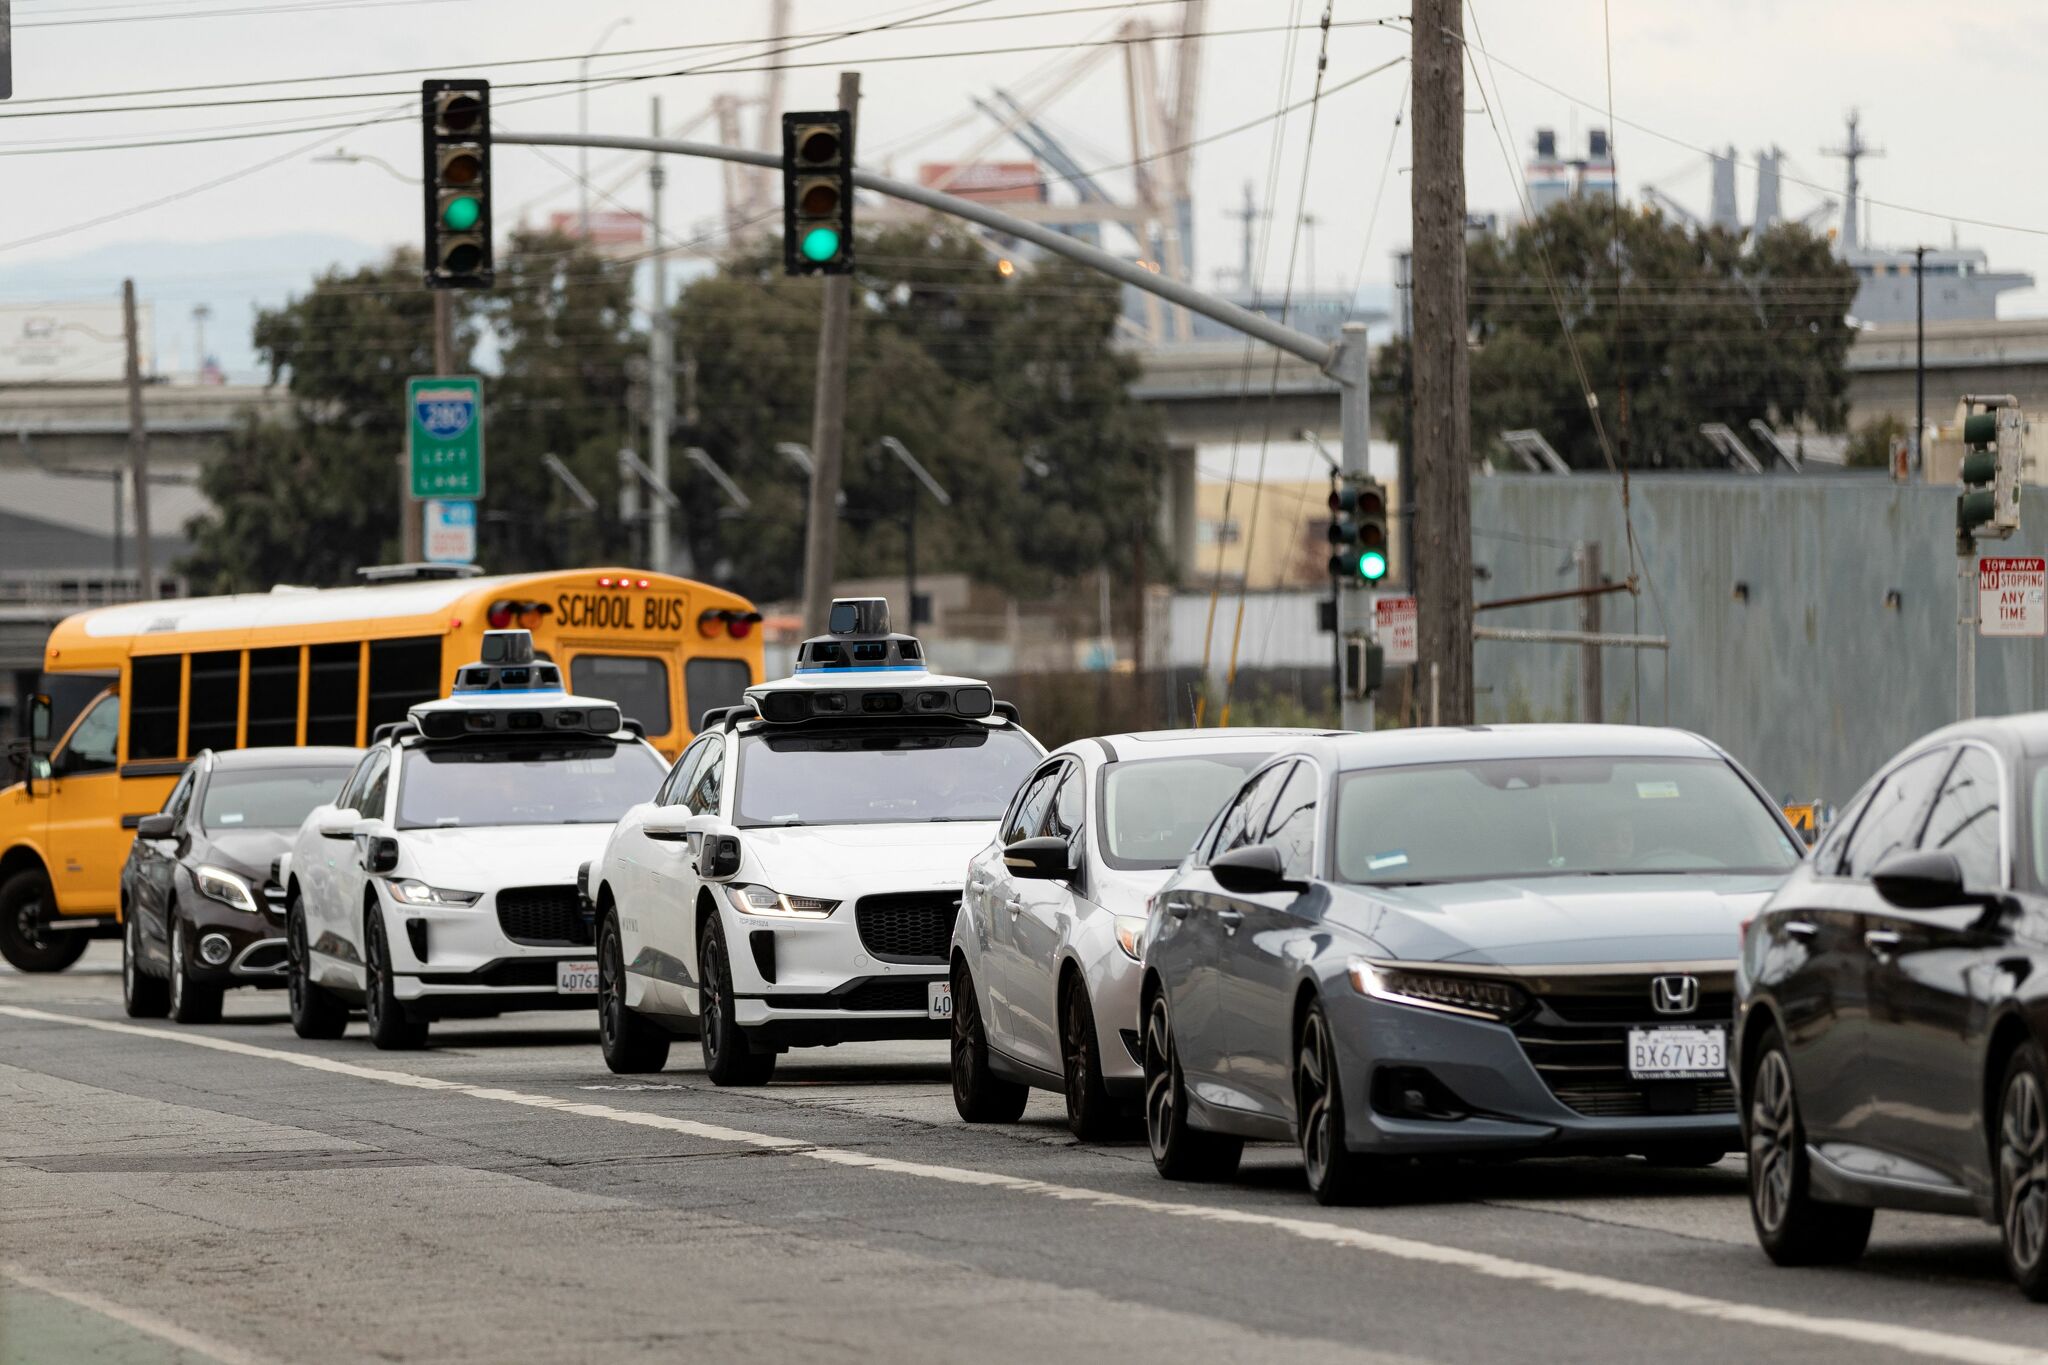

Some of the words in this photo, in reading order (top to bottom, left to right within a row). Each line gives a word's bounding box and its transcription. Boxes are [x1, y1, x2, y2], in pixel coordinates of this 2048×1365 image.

[421, 450, 467, 465] LEFT
[421, 473, 468, 489] LANE
[1985, 559, 2039, 571] TOW-AWAY
[1981, 571, 1999, 590] NO
[2001, 573, 2043, 588] STOPPING
[2000, 591, 2025, 605] ANY
[557, 594, 634, 629] SCHOOL
[643, 597, 684, 631] BUS
[2000, 606, 2027, 621] TIME
[1635, 1044, 1721, 1068] BX67V33
